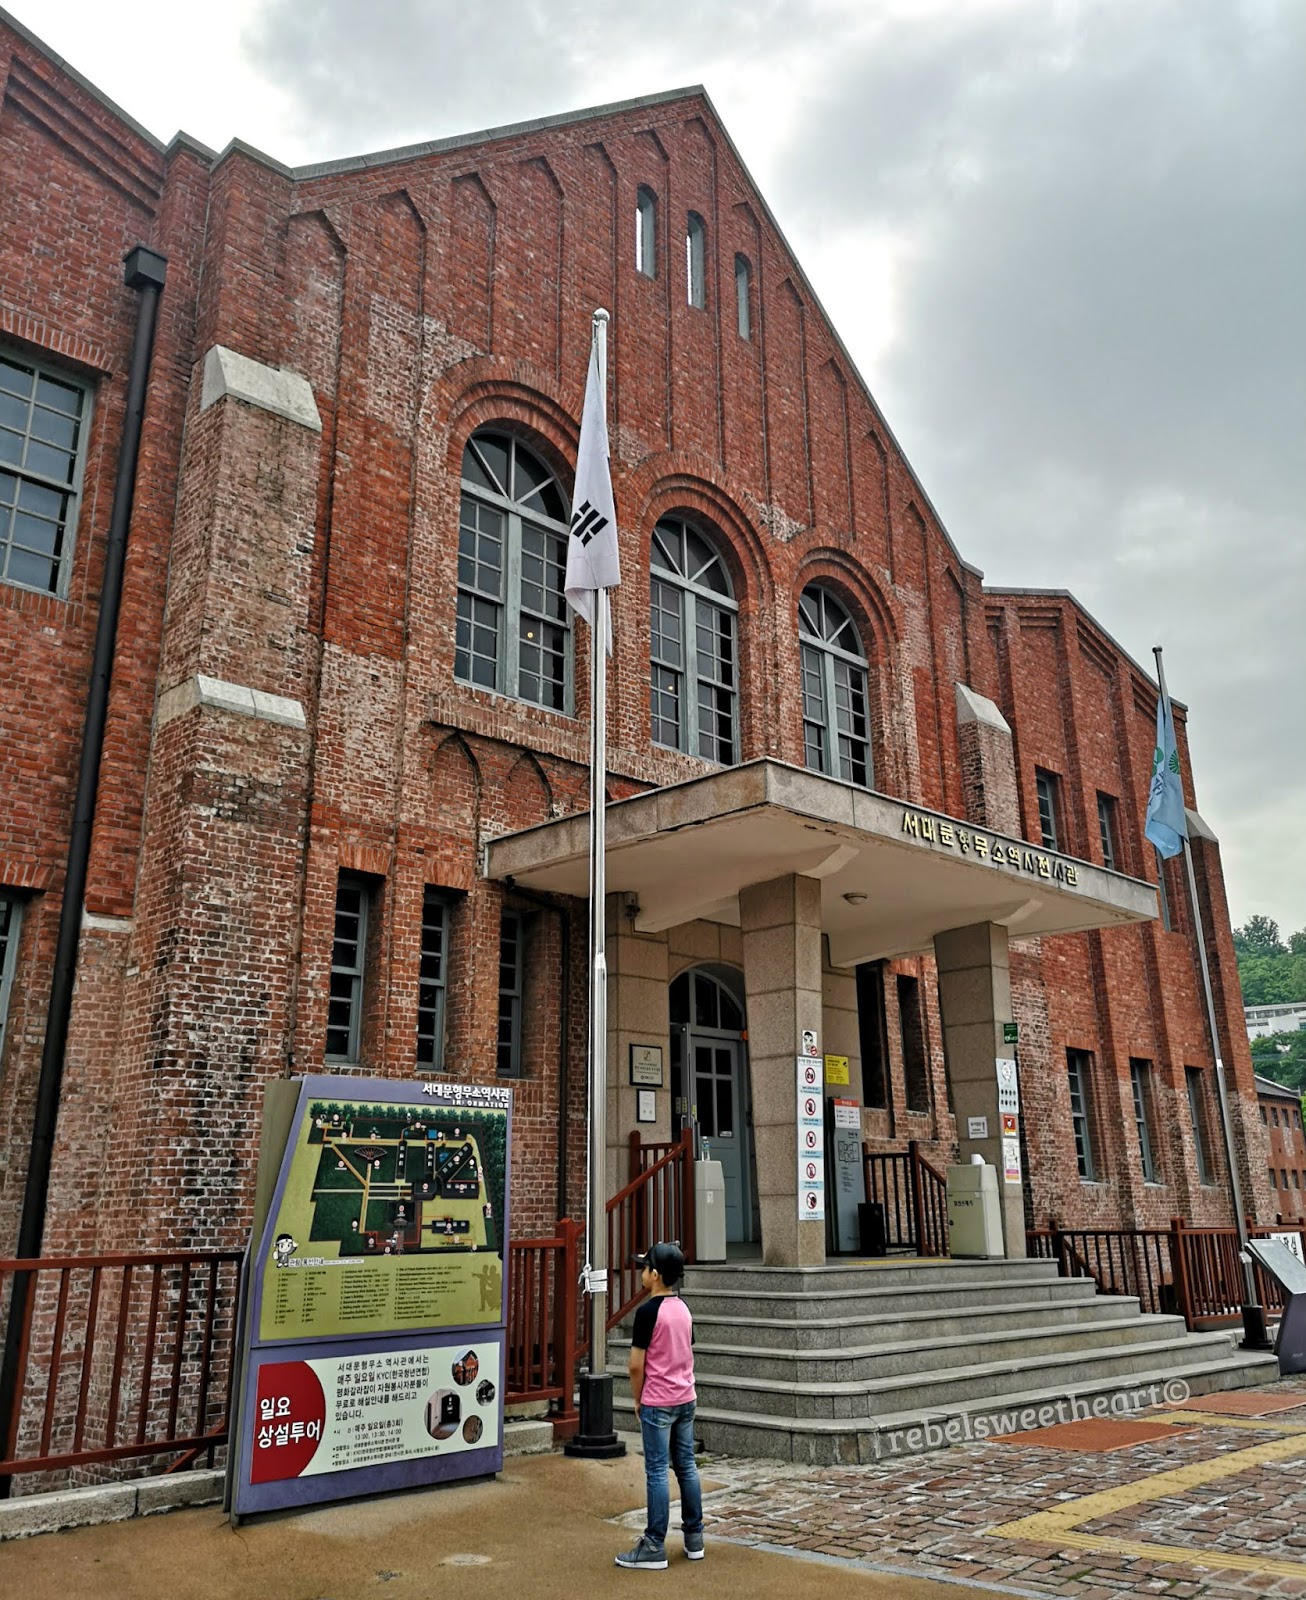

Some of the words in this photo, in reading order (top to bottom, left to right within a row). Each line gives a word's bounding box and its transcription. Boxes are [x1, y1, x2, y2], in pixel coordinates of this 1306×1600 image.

[422, 1083, 510, 1102] 서대문형무소역사관
[337, 1360, 383, 1372] 서대문형무소
[385, 1355, 429, 1367] 역사관에서는
[337, 1374, 352, 1385] 매주
[354, 1371, 375, 1384] 일요일
[377, 1378, 429, 1392] 자원봉사자분들이
[260, 1397, 291, 1420] 일요
[336, 1398, 355, 1409] 무료로
[357, 1394, 389, 1407] 해설안내를
[391, 1391, 417, 1402] 해드리고
[335, 1409, 364, 1421] 있습니다.
[257, 1419, 320, 1449] 상설투어
